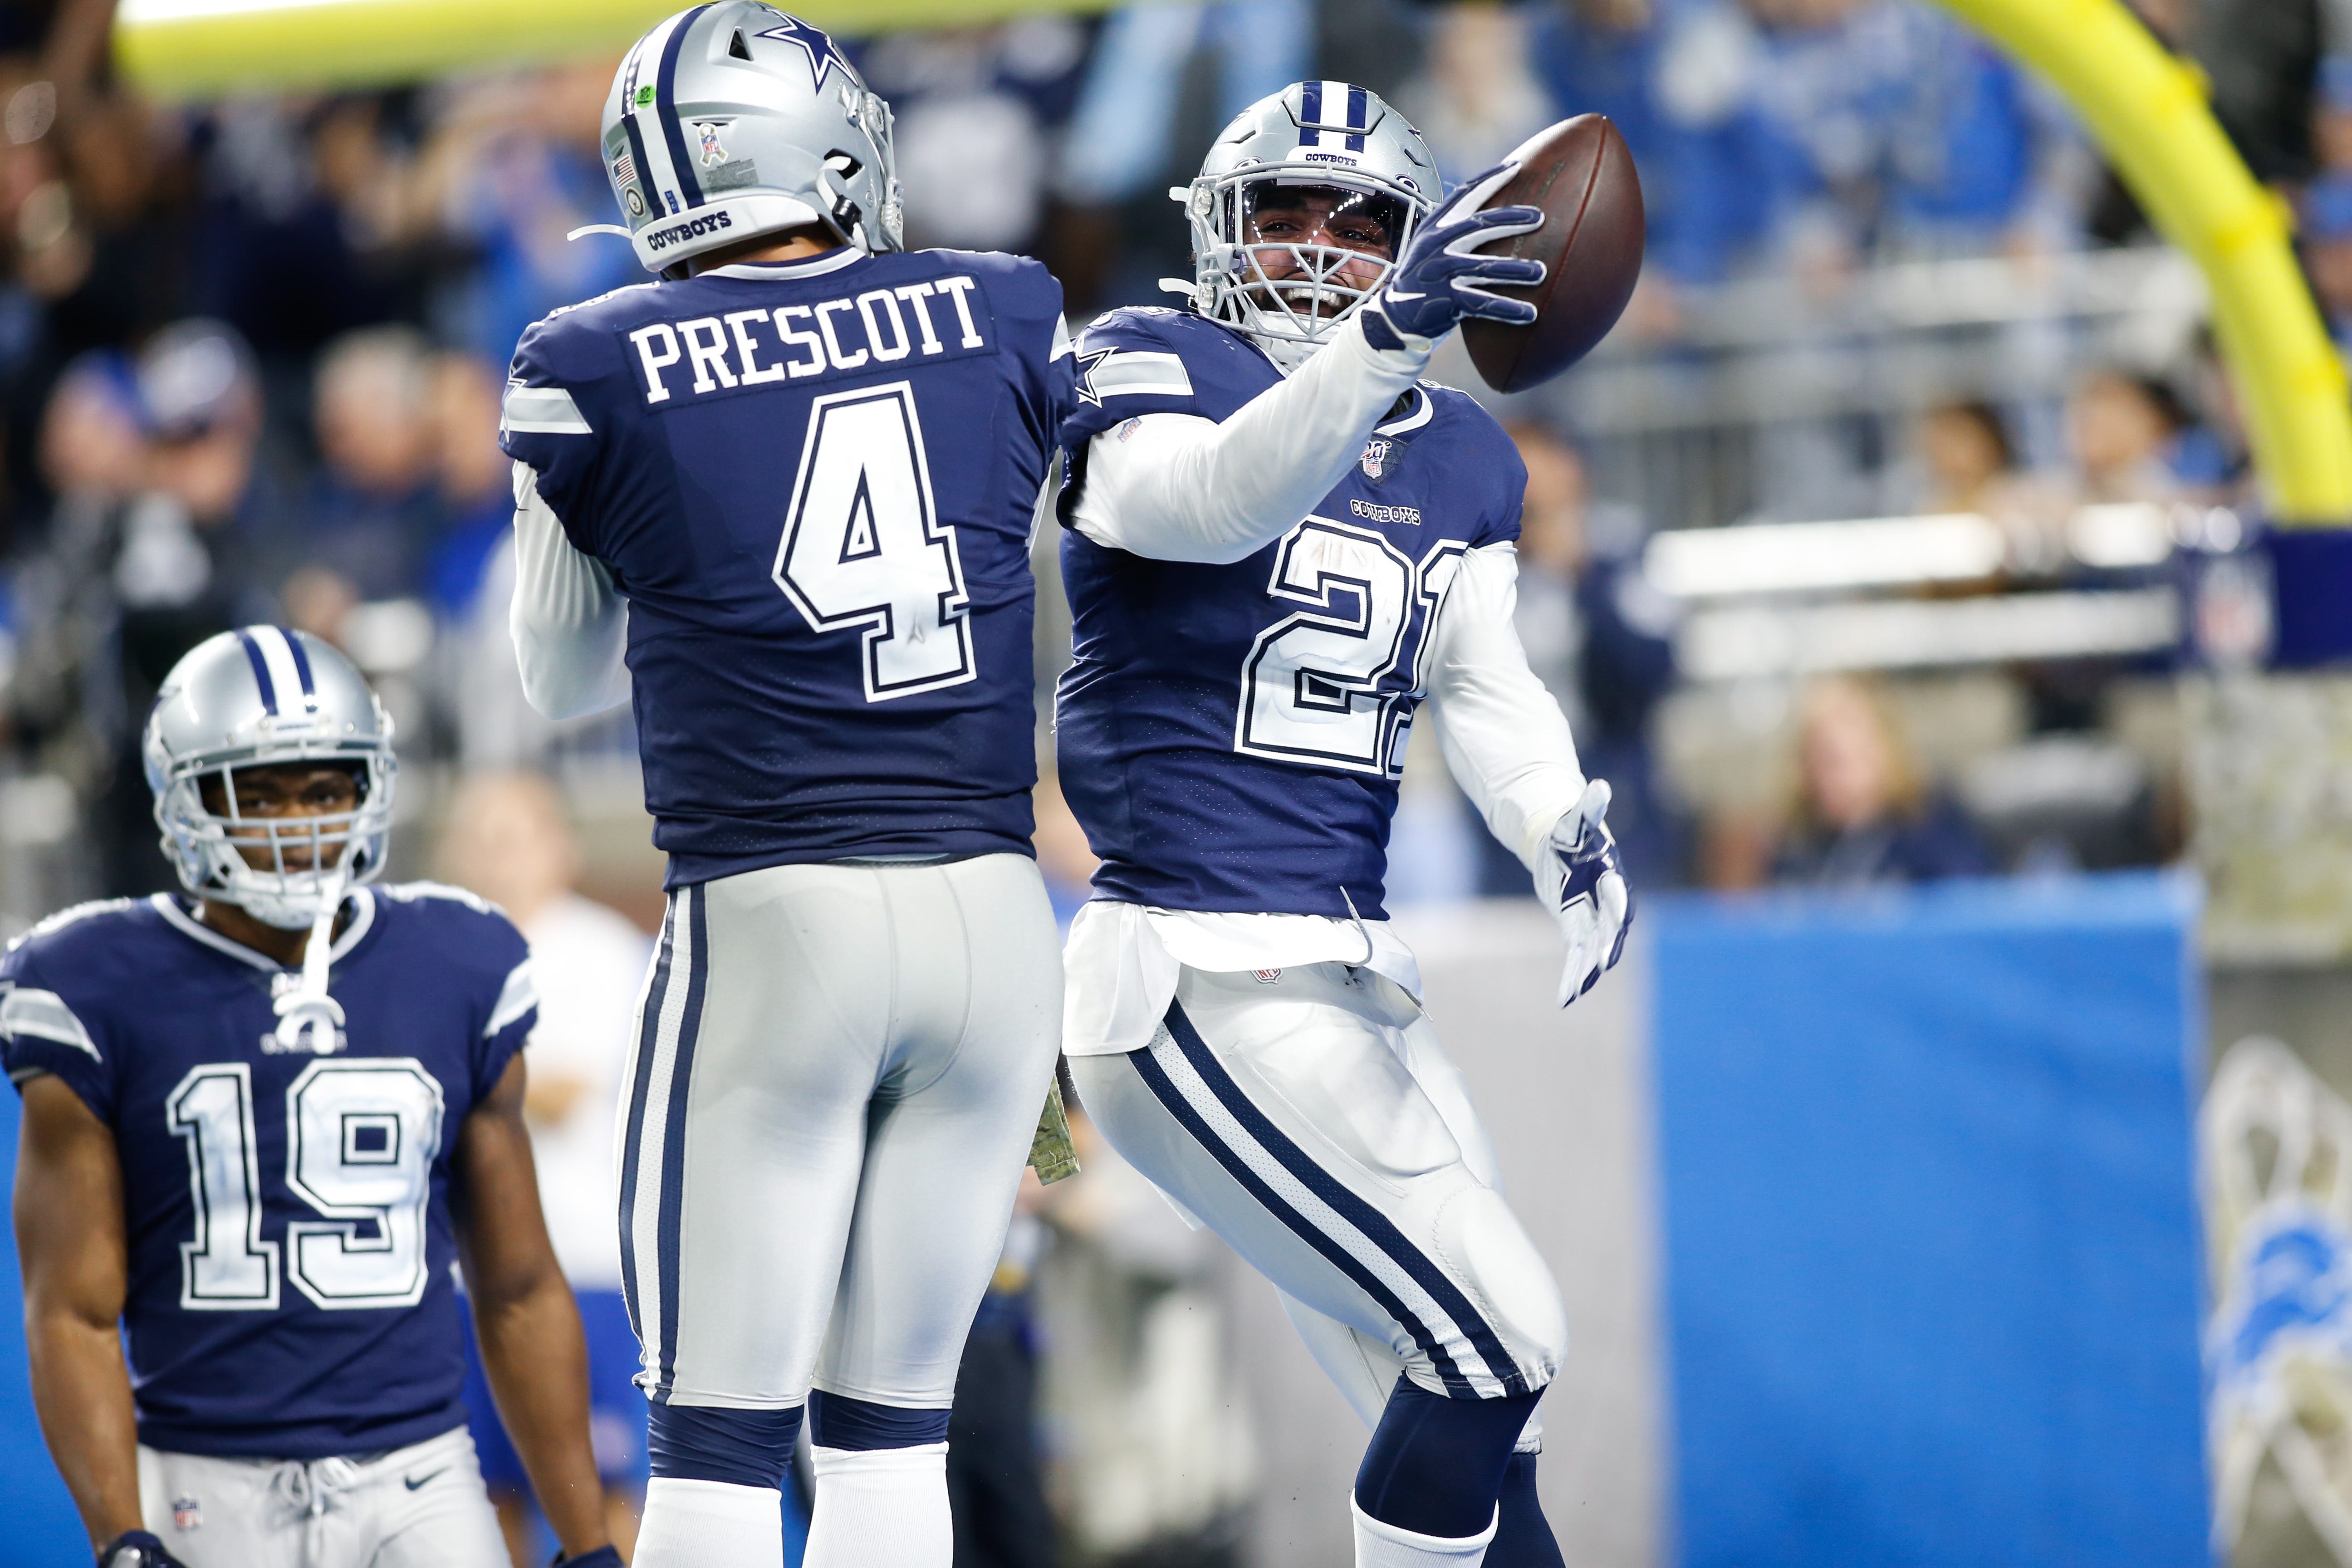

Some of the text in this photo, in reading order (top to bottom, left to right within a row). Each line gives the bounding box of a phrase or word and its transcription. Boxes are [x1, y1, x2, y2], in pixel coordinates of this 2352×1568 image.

[704, 142, 720, 152] NFL
[1305, 153, 1357, 166] COWBOYS
[647, 210, 731, 250] COWBOYS
[629, 275, 984, 404] PRESCOTT
[1367, 463, 1380, 473] NFL
[1350, 499, 1421, 526] COWBOYS
[771, 380, 977, 703] 4
[165, 1057, 445, 1310] 19
